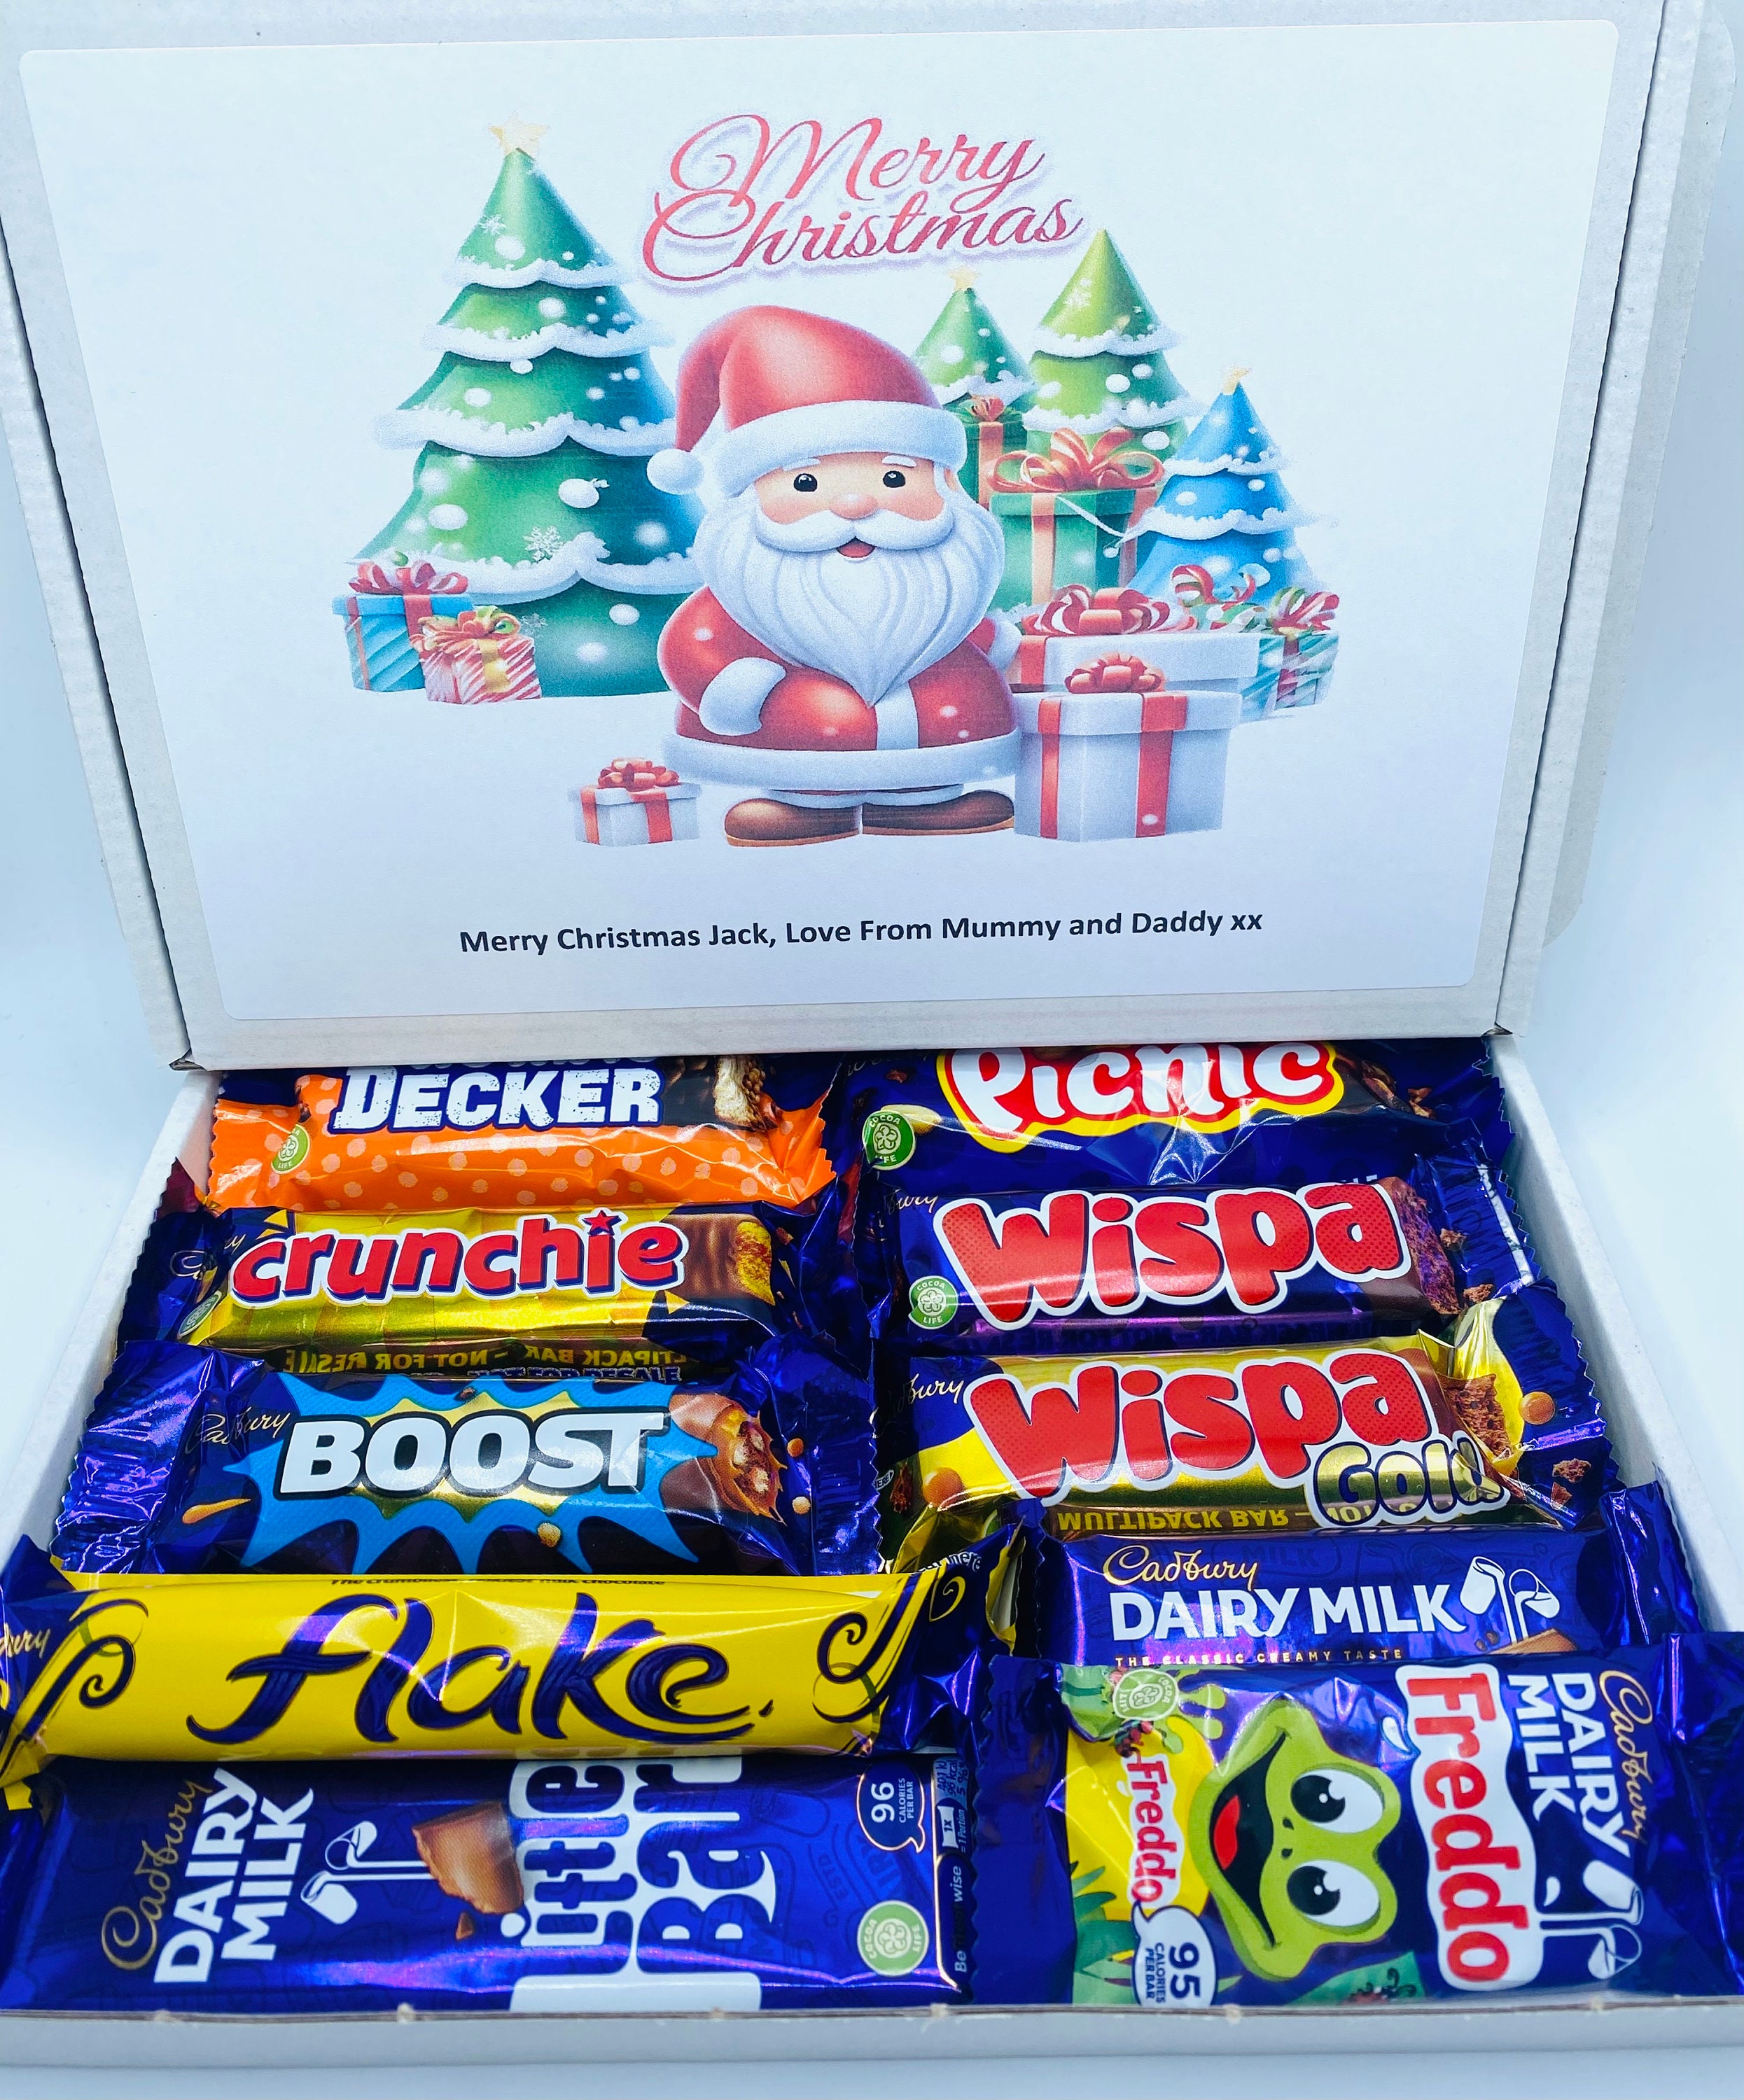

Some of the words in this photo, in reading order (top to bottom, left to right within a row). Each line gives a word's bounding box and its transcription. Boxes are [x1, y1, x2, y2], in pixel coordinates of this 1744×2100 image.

[670, 115, 1045, 213] Merry
[642, 190, 1082, 281] Christmas
[461, 930, 547, 955] Merry
[558, 926, 700, 950] Christmas
[709, 922, 776, 948] Jack,
[786, 920, 851, 944] Love
[860, 919, 932, 941] From
[942, 917, 1061, 940] Mummy
[1069, 913, 1122, 935] and
[1132, 910, 1222, 936] Daddy
[1230, 912, 1263, 931] xx
[330, 1063, 663, 1131] DECKER
[869, 1114, 901, 1128] COCOA
[230, 1208, 683, 1303] crunchie
[940, 1183, 1405, 1323] Wispa
[917, 1281, 945, 1291] COCOA
[923, 1316, 943, 1324] LIFE
[280, 1412, 667, 1493] BOOST
[971, 1352, 1432, 1497] Wispa
[1315, 1436, 1505, 1526] Gold
[1103, 1544, 1258, 1592] Cadbury
[1109, 1588, 1300, 1642] DAIRY
[1309, 1583, 1467, 1634] MILK
[1115, 1656, 1151, 1667] THE
[1162, 1653, 1251, 1666] CLASSIC
[1257, 1651, 1331, 1662] CREAMY
[1344, 1648, 1403, 1660] TASTE
[1509, 1674, 1574, 1821] MILK
[1551, 1673, 1630, 1856] DAIRY
[1599, 1669, 1651, 1844] Cadbury
[870, 1782, 895, 1823] 96
[898, 1778, 907, 1823] CALORIES
[1126, 1756, 1176, 1904] Freddo
[1407, 1672, 1521, 1982] Freddo
[102, 1776, 213, 1970] Cadbury
[153, 1768, 258, 1983] DAIRY
[221, 1787, 316, 1961] MILK
[864, 1919, 878, 1959] COCOA
[912, 1924, 922, 1954] LIFE
[954, 1950, 968, 1973] Be
[1145, 1948, 1155, 1972] PER
[1169, 1942, 1201, 2000] 95
[1145, 1974, 1155, 1998] BAR
[1154, 1942, 1166, 2003] CALORIES
